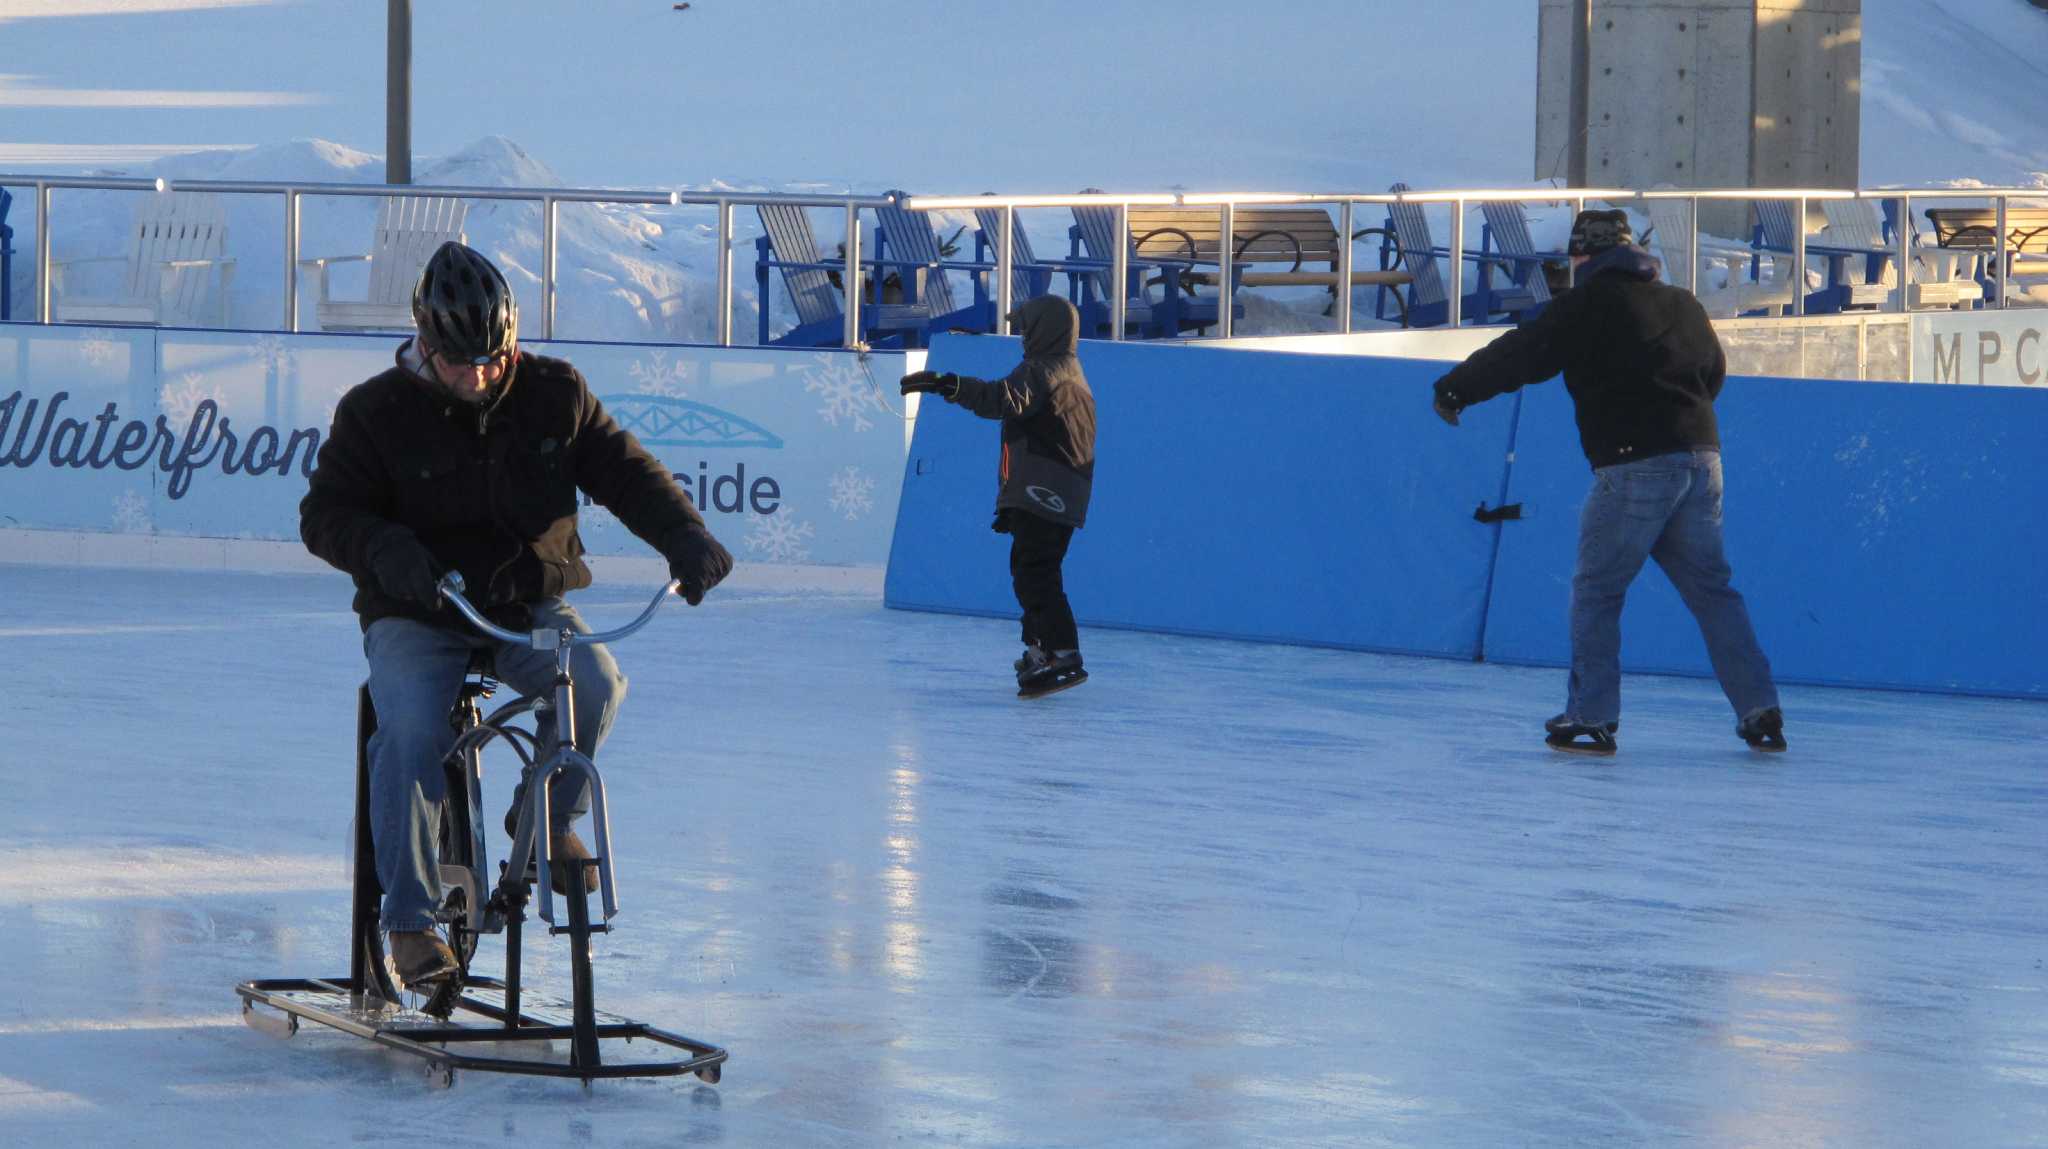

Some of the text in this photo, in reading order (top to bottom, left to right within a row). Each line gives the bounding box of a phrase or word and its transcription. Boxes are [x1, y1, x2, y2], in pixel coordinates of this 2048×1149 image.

[1933, 328, 2048, 385] MPC
[0, 390, 321, 499] Waterfron
[671, 461, 781, 515] side
